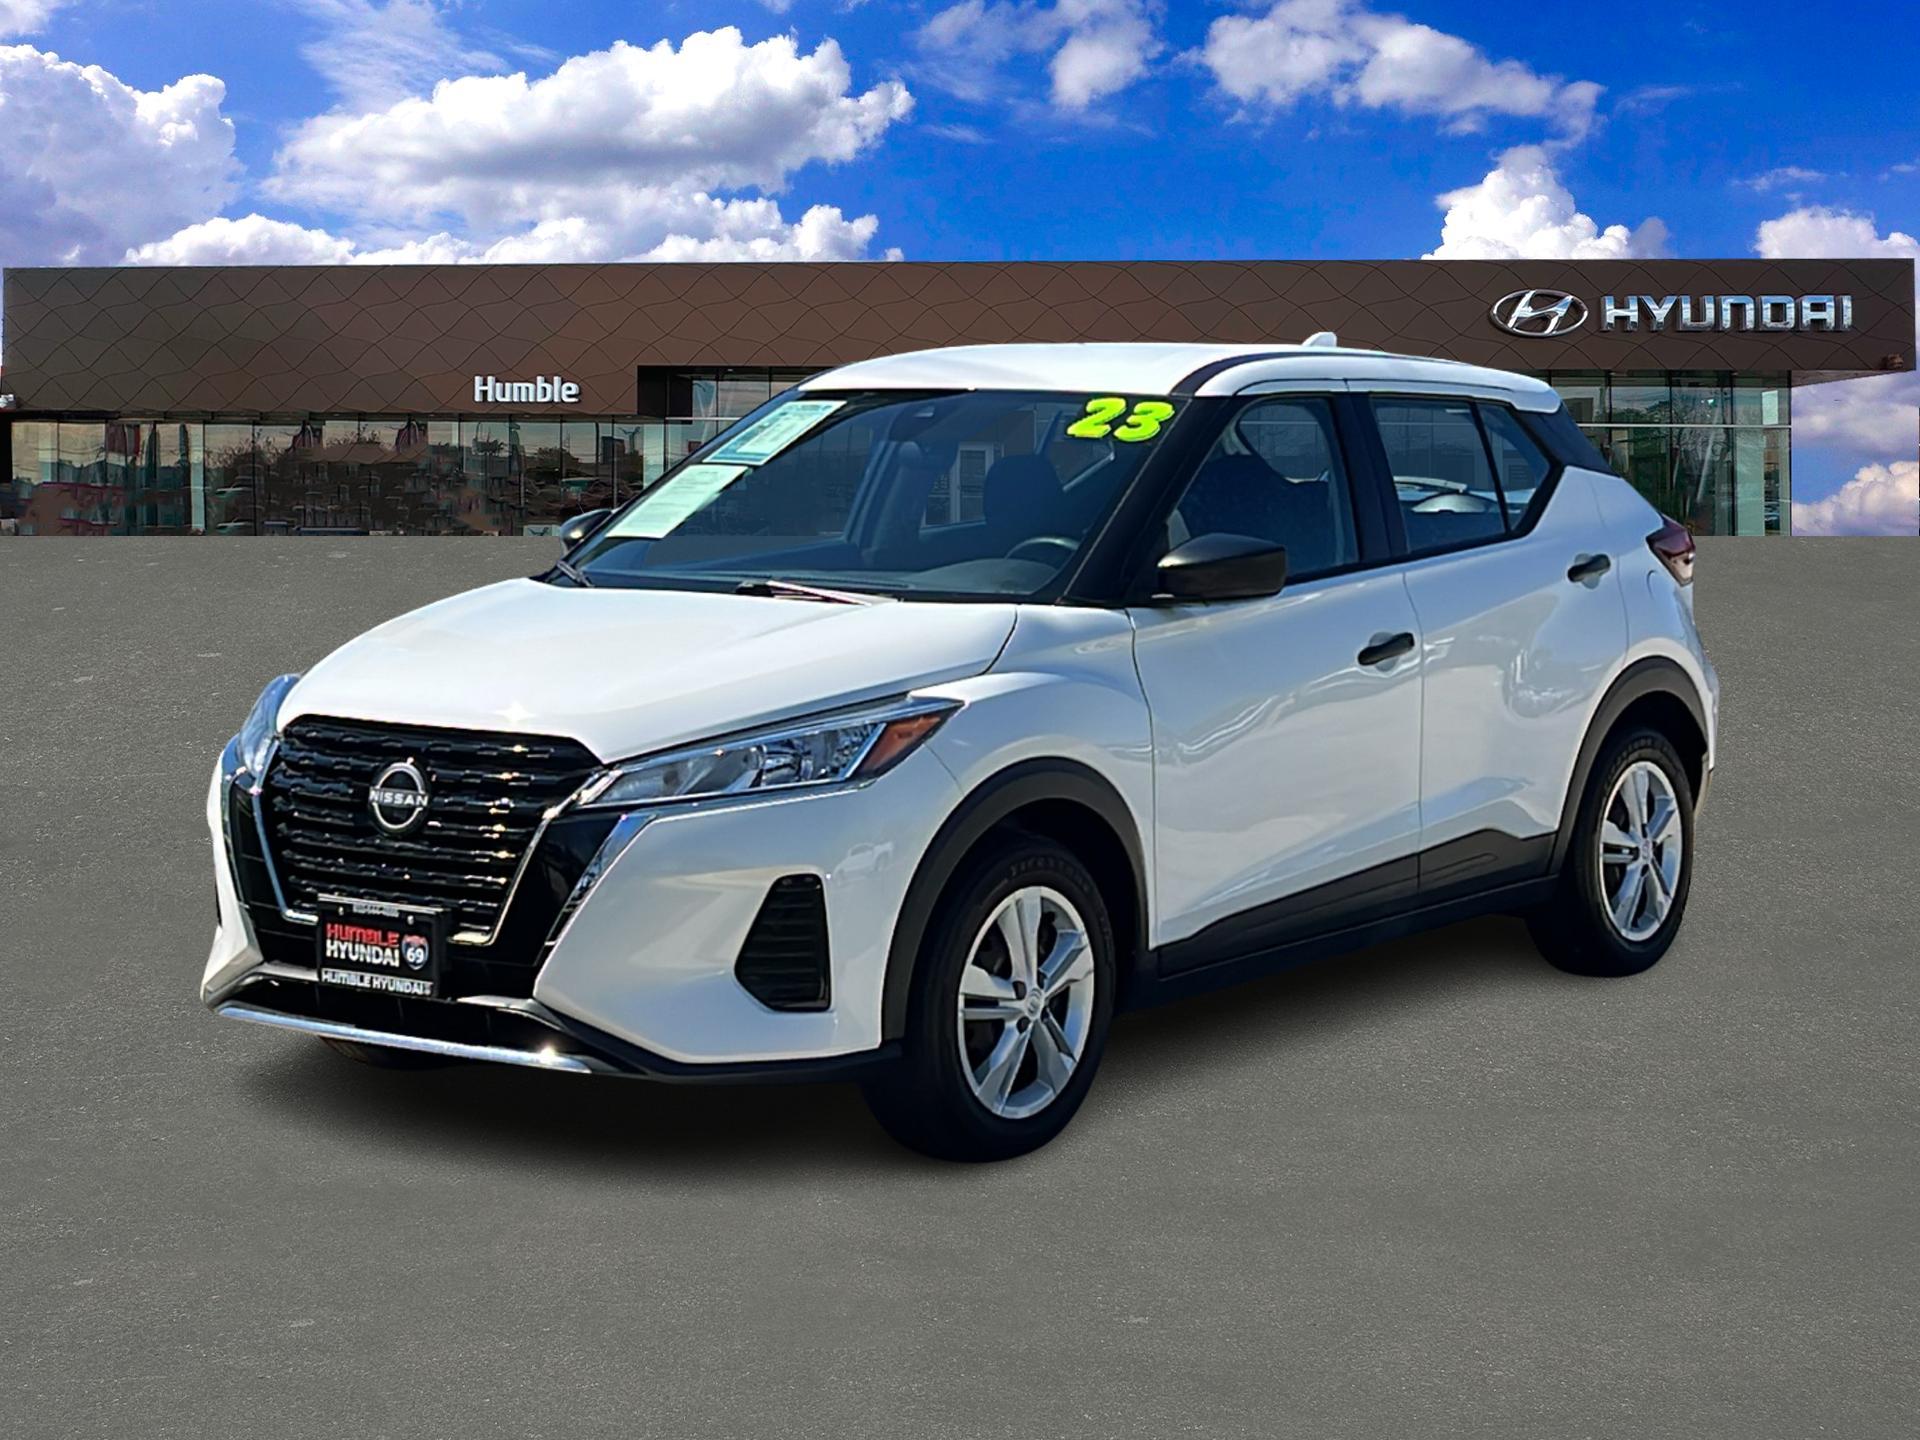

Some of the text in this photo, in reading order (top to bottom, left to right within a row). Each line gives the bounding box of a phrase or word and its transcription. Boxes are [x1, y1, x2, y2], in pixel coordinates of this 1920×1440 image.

[1600, 294, 1853, 332] HYUNDAI
[474, 375, 580, 403] Humble
[1066, 397, 1175, 442] 23
[369, 790, 428, 807] NISSAN
[326, 923, 400, 948] HUMBLE
[326, 940, 400, 967] HYUNDAI
[406, 947, 425, 964] 69
[322, 970, 371, 988] HUMBLE
